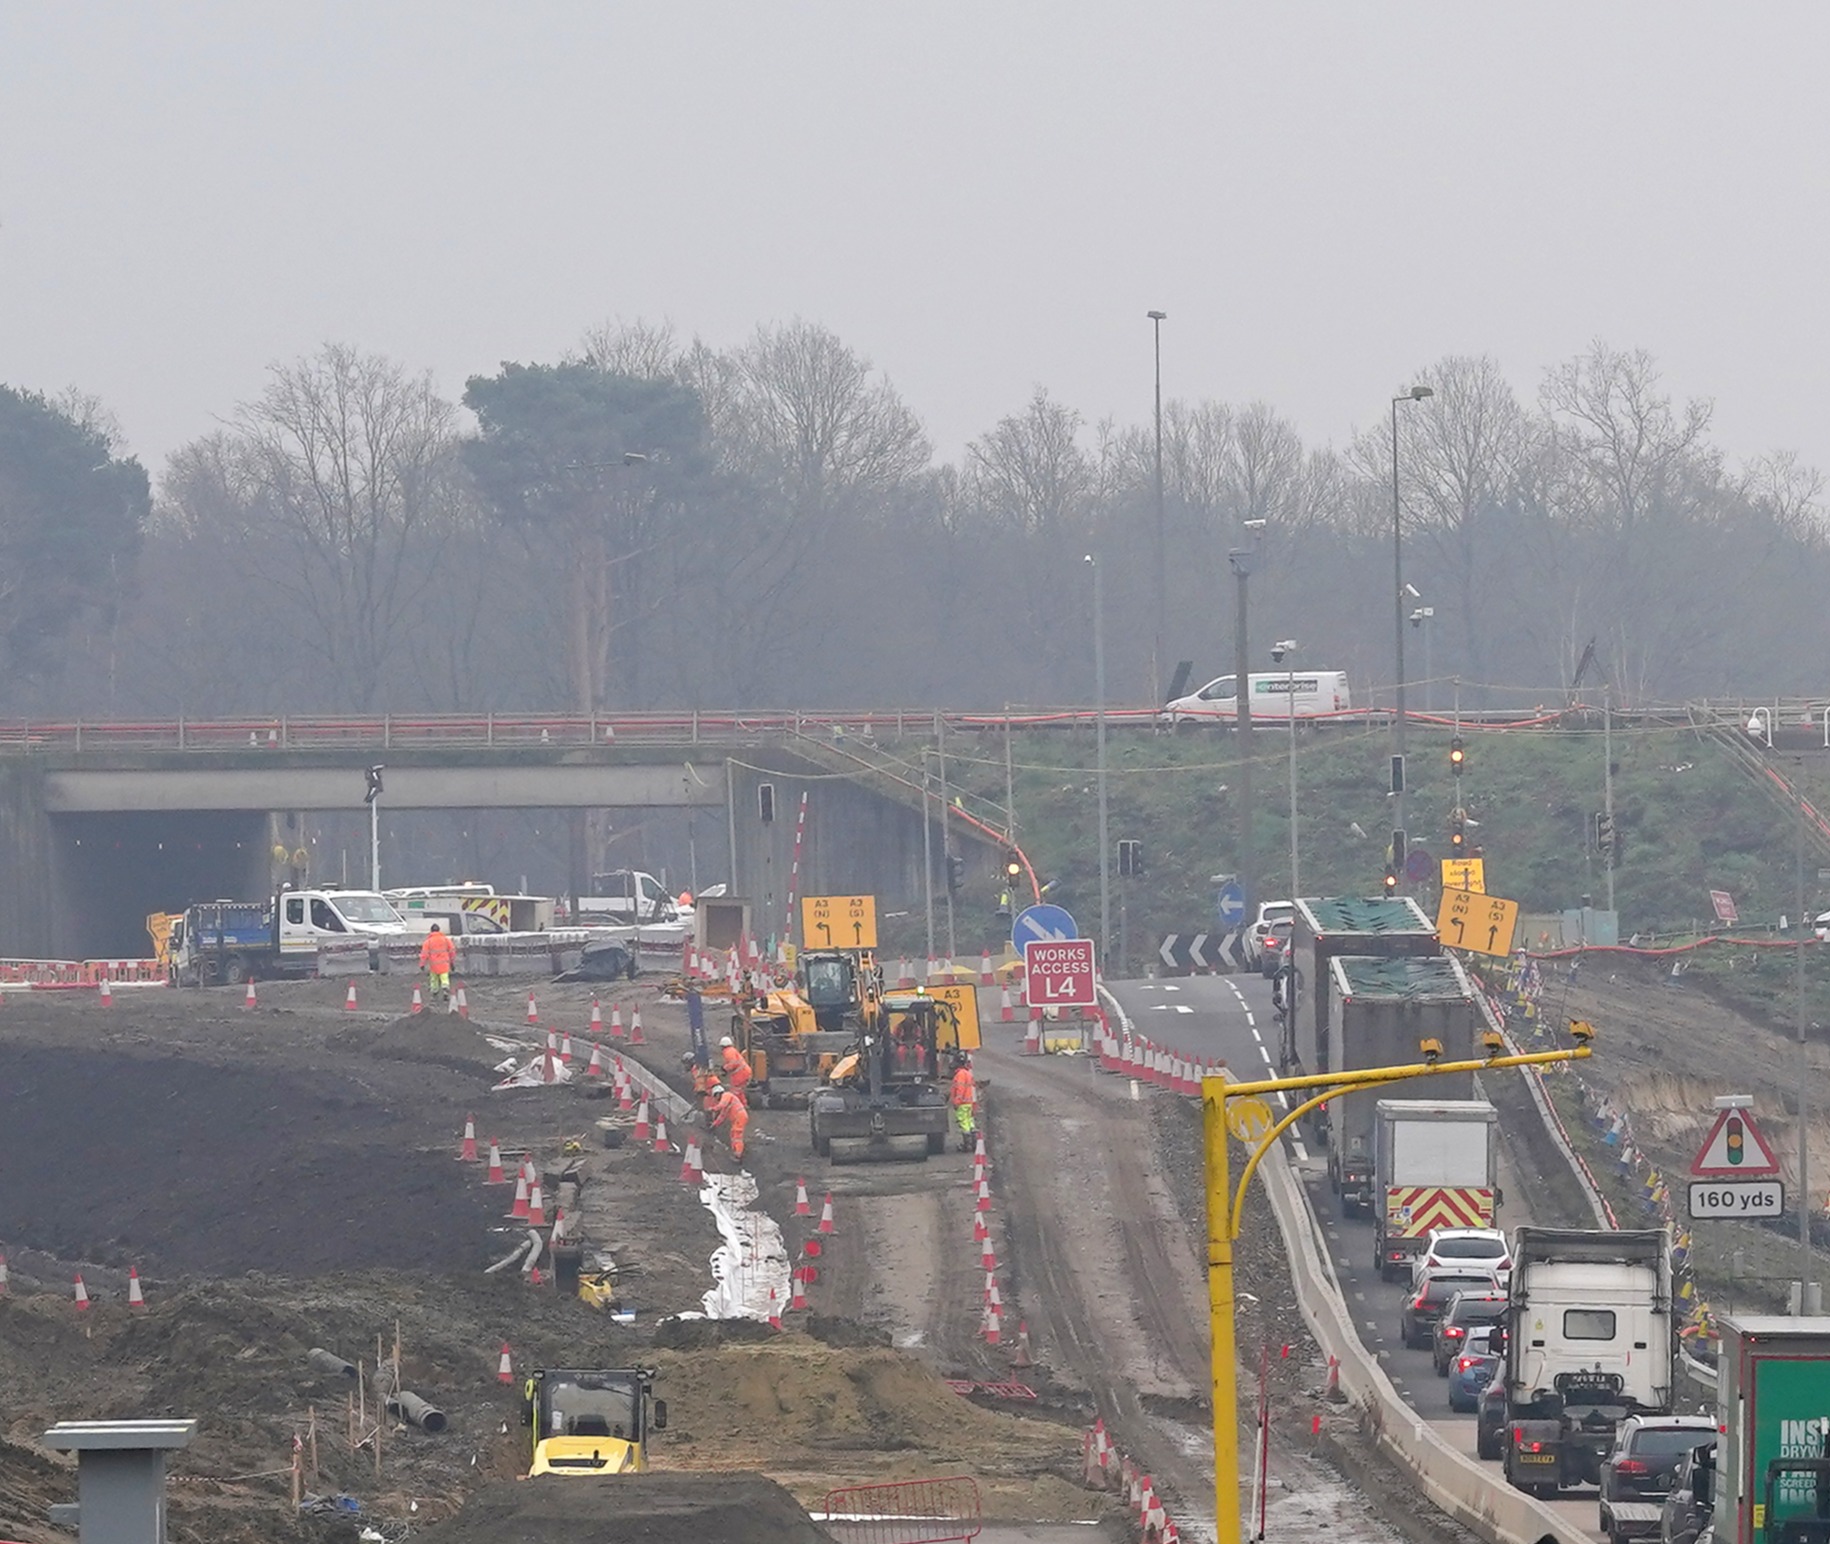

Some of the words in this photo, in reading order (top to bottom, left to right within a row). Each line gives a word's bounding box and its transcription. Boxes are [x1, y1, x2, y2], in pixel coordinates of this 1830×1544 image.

[850, 899, 864, 907] A3
[1456, 893, 1470, 903] A3
[815, 900, 829, 908] A3
[1491, 901, 1506, 911] A3
[1034, 948, 1086, 961] WORKS
[1031, 962, 1090, 975] ACCESS
[1046, 976, 1076, 998] L4
[1699, 1192, 1735, 1209] 160
[1741, 1191, 1774, 1210] yds
